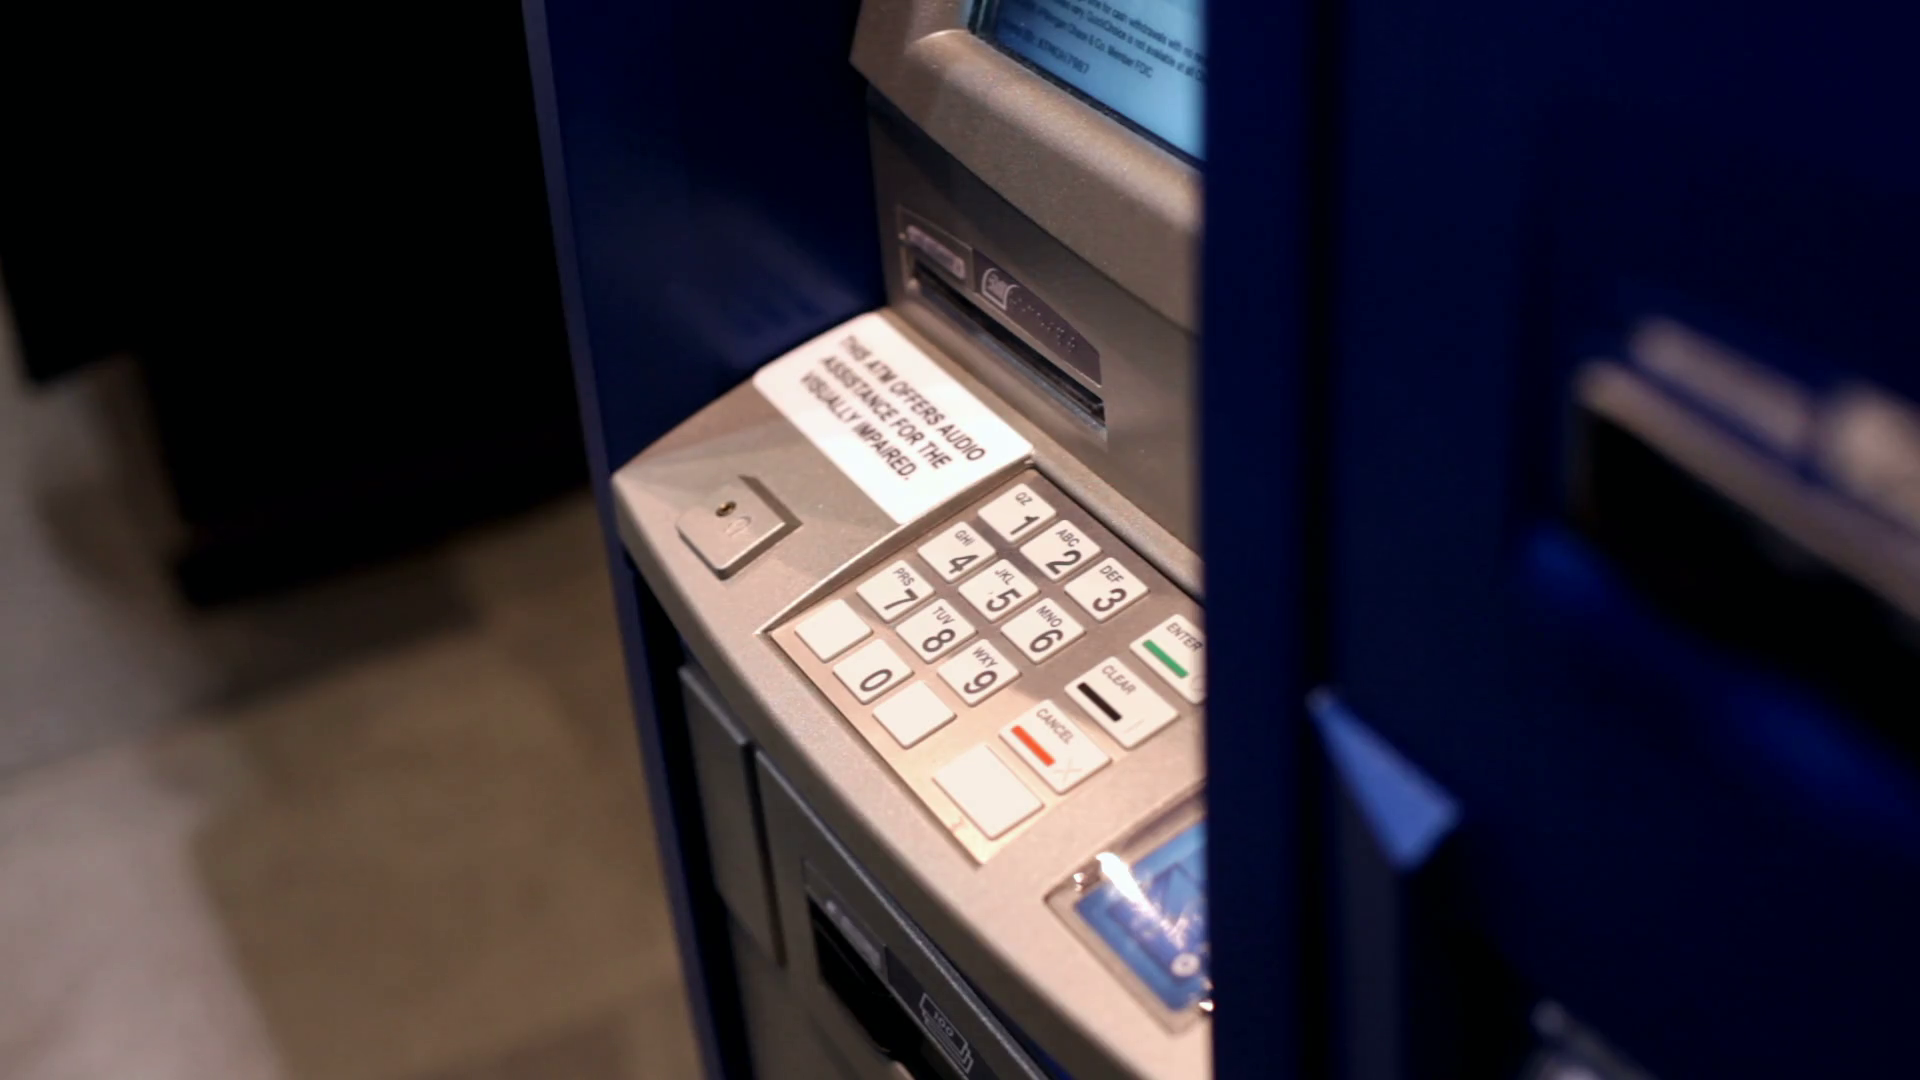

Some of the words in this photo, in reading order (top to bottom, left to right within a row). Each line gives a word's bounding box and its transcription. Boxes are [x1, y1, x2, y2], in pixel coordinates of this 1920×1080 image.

[1134, 60, 1154, 79] FDIC
[840, 334, 871, 361] THIS
[865, 360, 897, 384] ATM
[889, 379, 946, 426] OFFERS
[939, 424, 985, 462] AUDIO
[819, 355, 897, 422] ASSISTANCE
[892, 418, 925, 445] FOR
[917, 440, 952, 470] THE
[800, 370, 863, 424] VISUALLY
[852, 421, 917, 481] IMPAIRED.
[1015, 491, 1033, 507] QZ
[1009, 515, 1040, 536] 1
[954, 529, 975, 547] GHI
[1055, 528, 1081, 548] ABC
[948, 554, 980, 575] 4
[1045, 549, 1082, 575] 2
[892, 567, 915, 587] PRS
[994, 568, 1016, 586] JKL
[1099, 565, 1124, 584] DEF
[883, 588, 919, 611] 7
[986, 587, 1022, 613] 5
[1092, 587, 1127, 612] 3
[932, 606, 955, 625] TUV
[1036, 605, 1063, 628] MNO
[922, 628, 956, 653] 8
[1029, 629, 1064, 654] 6
[1165, 621, 1203, 652] ENTER
[972, 646, 999, 668] WXY
[963, 670, 998, 695] 9
[1101, 664, 1137, 695] CLEAR
[1036, 707, 1074, 745] CANCEL
